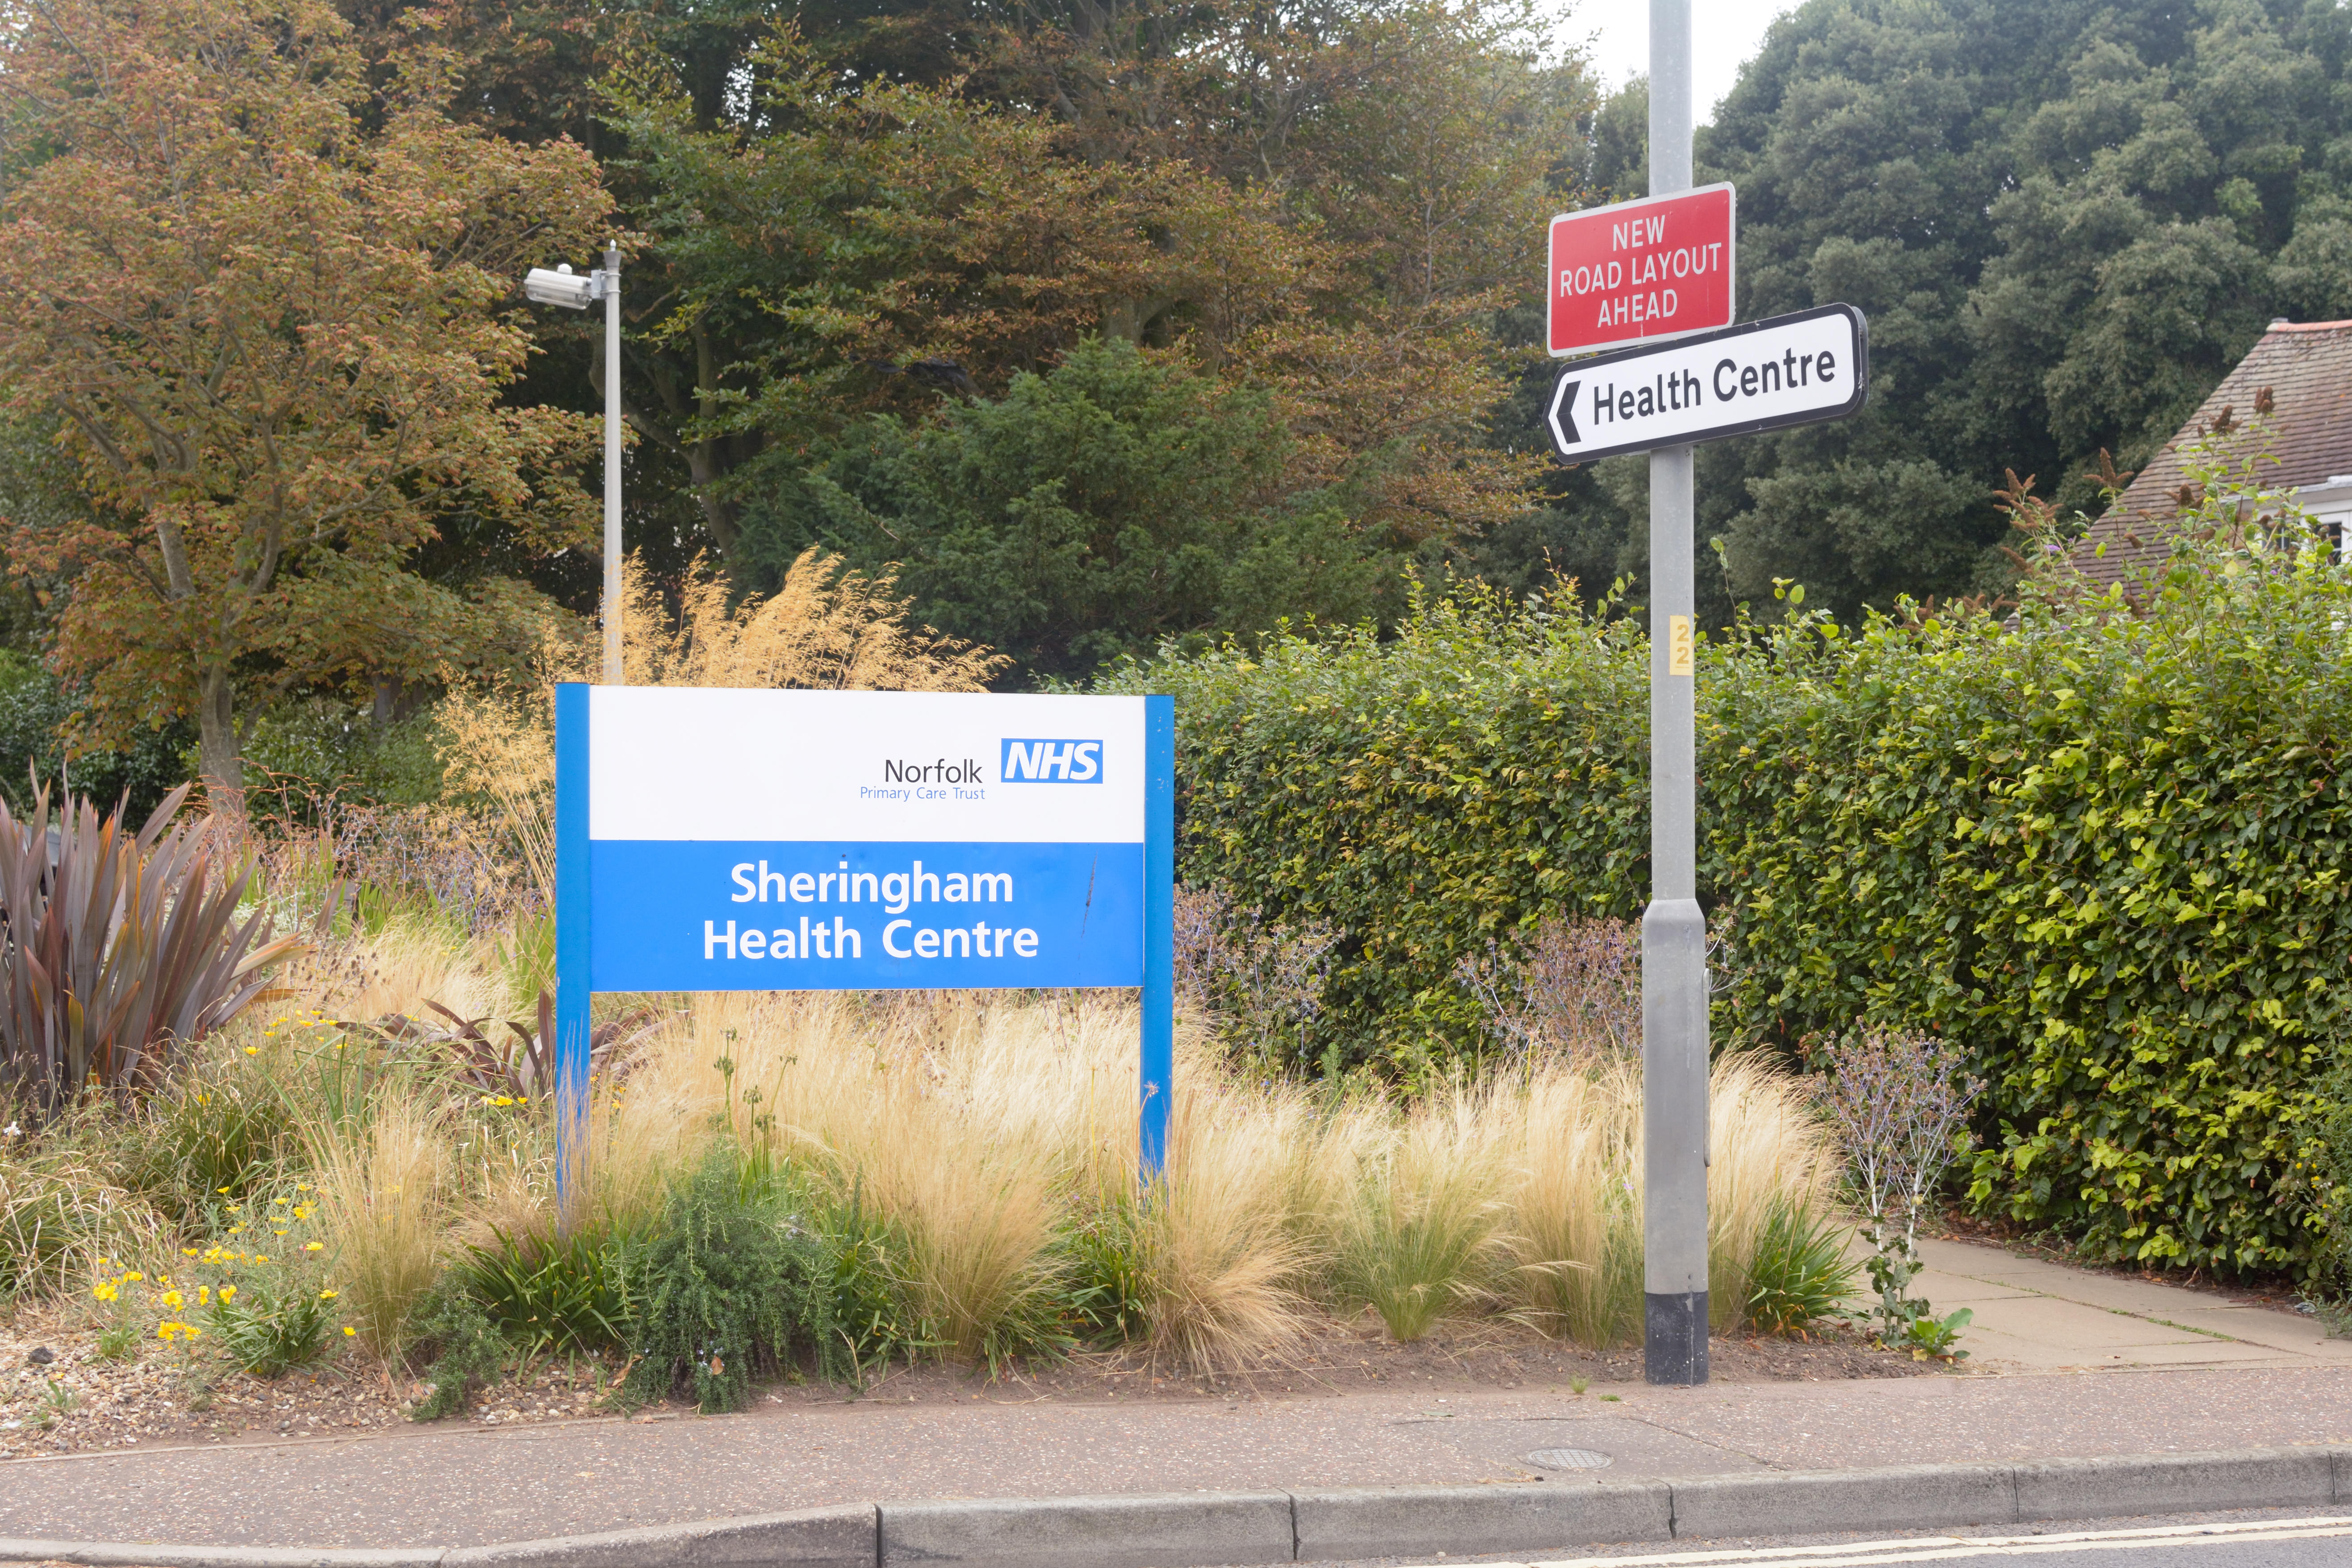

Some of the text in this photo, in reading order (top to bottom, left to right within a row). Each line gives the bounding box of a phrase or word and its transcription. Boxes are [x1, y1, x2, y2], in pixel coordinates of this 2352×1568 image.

[1613, 214, 1665, 252] NEW
[1560, 242, 1722, 298] ROAD LAYOUT
[1597, 289, 1677, 328] AHEAD
[1594, 348, 1836, 425] Health Centre
[885, 758, 983, 784] Norfolk
[1004, 742, 1100, 780] NHS
[860, 786, 985, 802] Primary Care Trust
[731, 860, 1013, 914] Sheringham
[704, 916, 1039, 959] Health Centre
